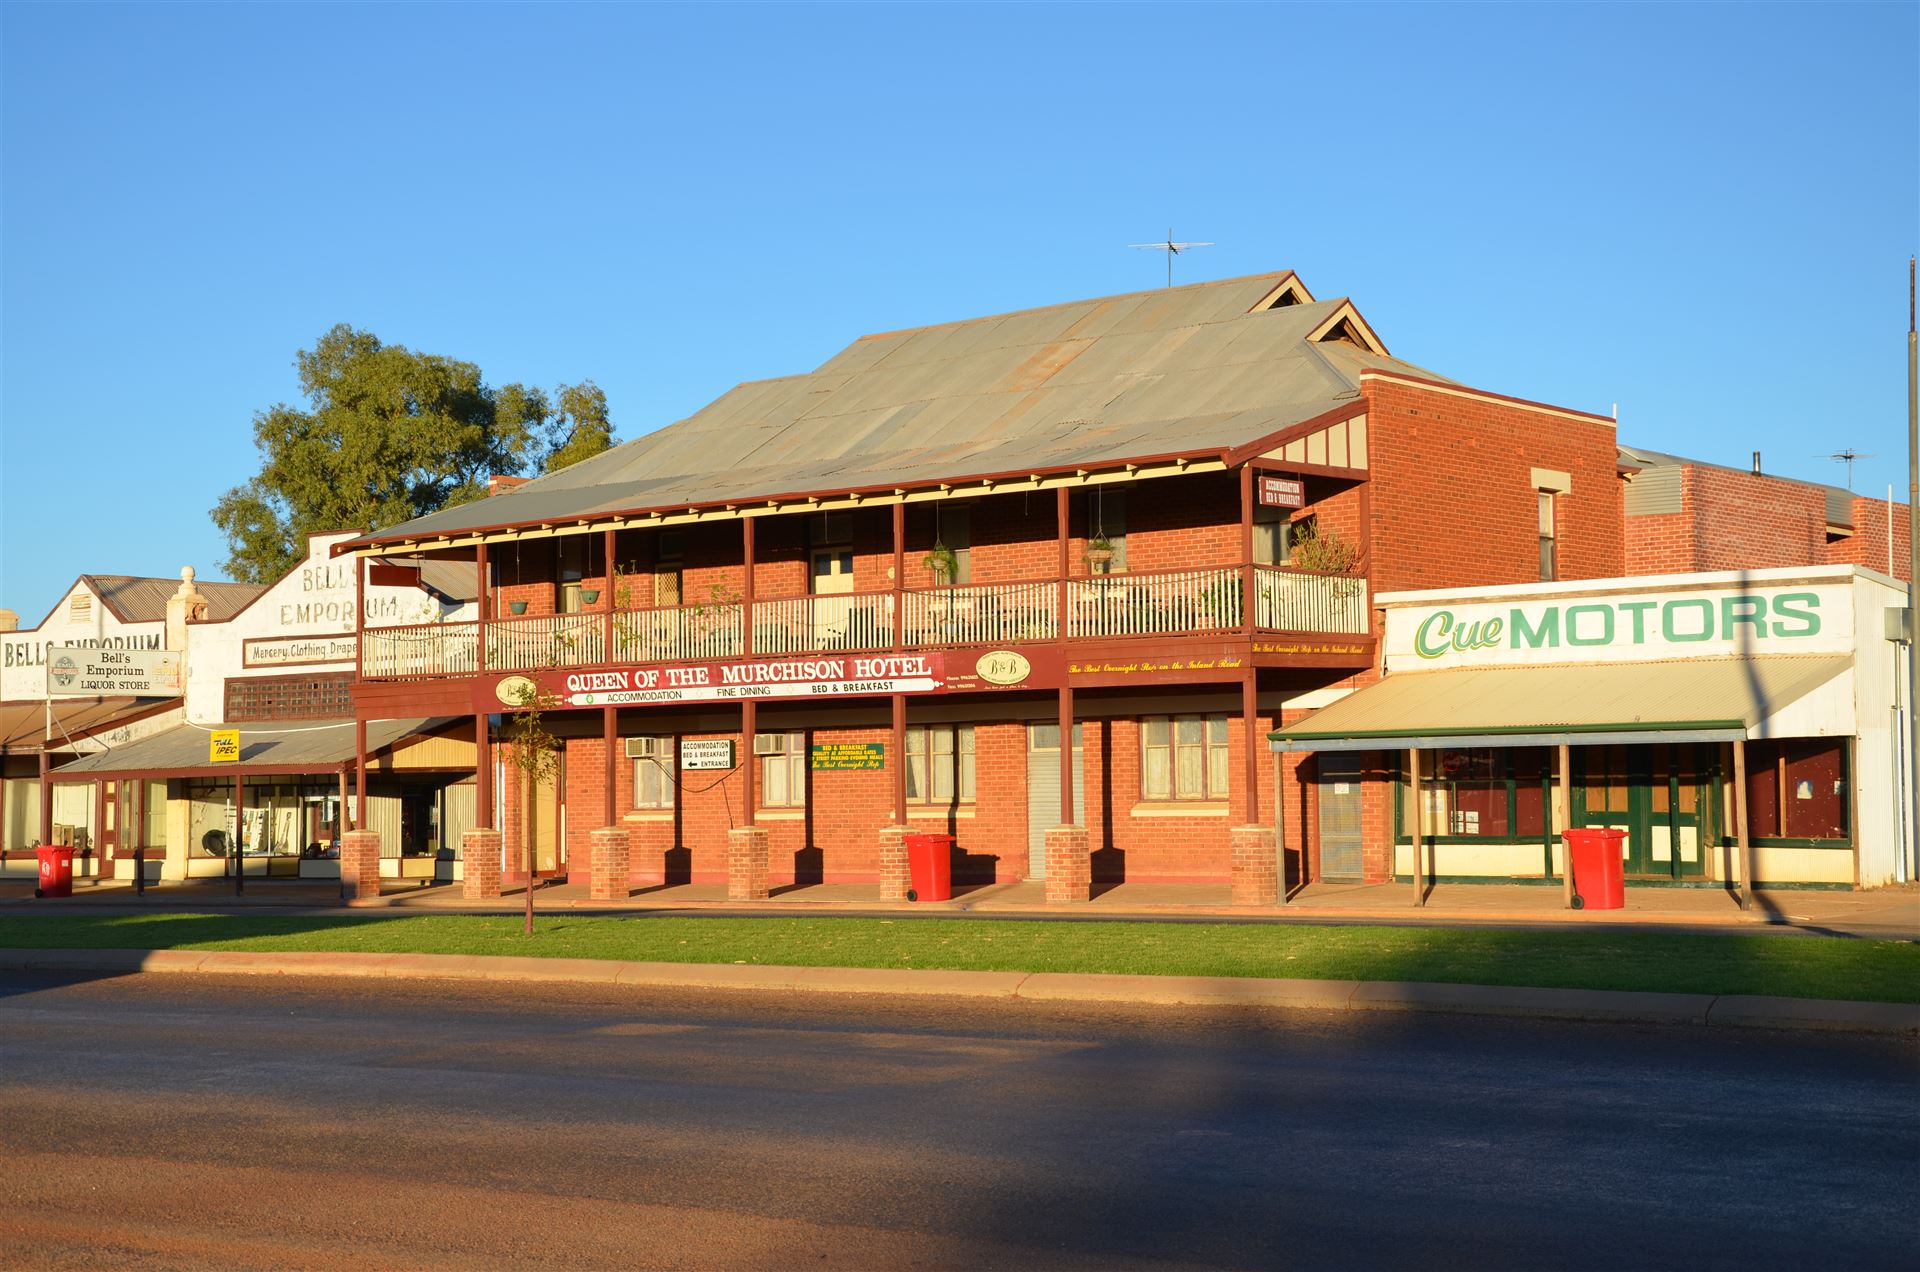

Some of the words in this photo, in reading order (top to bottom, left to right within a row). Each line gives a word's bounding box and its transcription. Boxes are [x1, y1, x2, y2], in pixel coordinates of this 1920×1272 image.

[280, 595, 397, 626] EMPORUM
[1414, 609, 1504, 660] Cue
[1509, 592, 1822, 650] MOTORS
[101, 652, 131, 664] Bell's
[86, 665, 145, 679] Emporium
[1069, 664, 1082, 673] The
[1084, 664, 1101, 673] Best
[1103, 663, 1138, 674] Overnight
[1140, 662, 1157, 673] Stop
[1171, 661, 1184, 670] the
[1187, 659, 1215, 669] Inland
[1217, 658, 1242, 668] Road
[566, 671, 629, 692] QUEEN
[634, 669, 660, 688] OF
[666, 667, 710, 687] THE
[720, 659, 845, 684] MURCHISON
[854, 656, 932, 678] HOTEL
[80, 681, 115, 691] LIQUOR
[119, 681, 150, 690] STORE
[607, 690, 682, 703] ACCOMMODATION
[716, 687, 737, 697] FINE
[740, 686, 771, 696] DINING
[811, 684, 828, 694] BED
[832, 684, 839, 693] &
[843, 681, 894, 692] BREAKFAST
[216, 745, 237, 755] IPEC
[683, 741, 729, 750] ACCOMMODATION
[837, 760, 865, 770] Overnight
